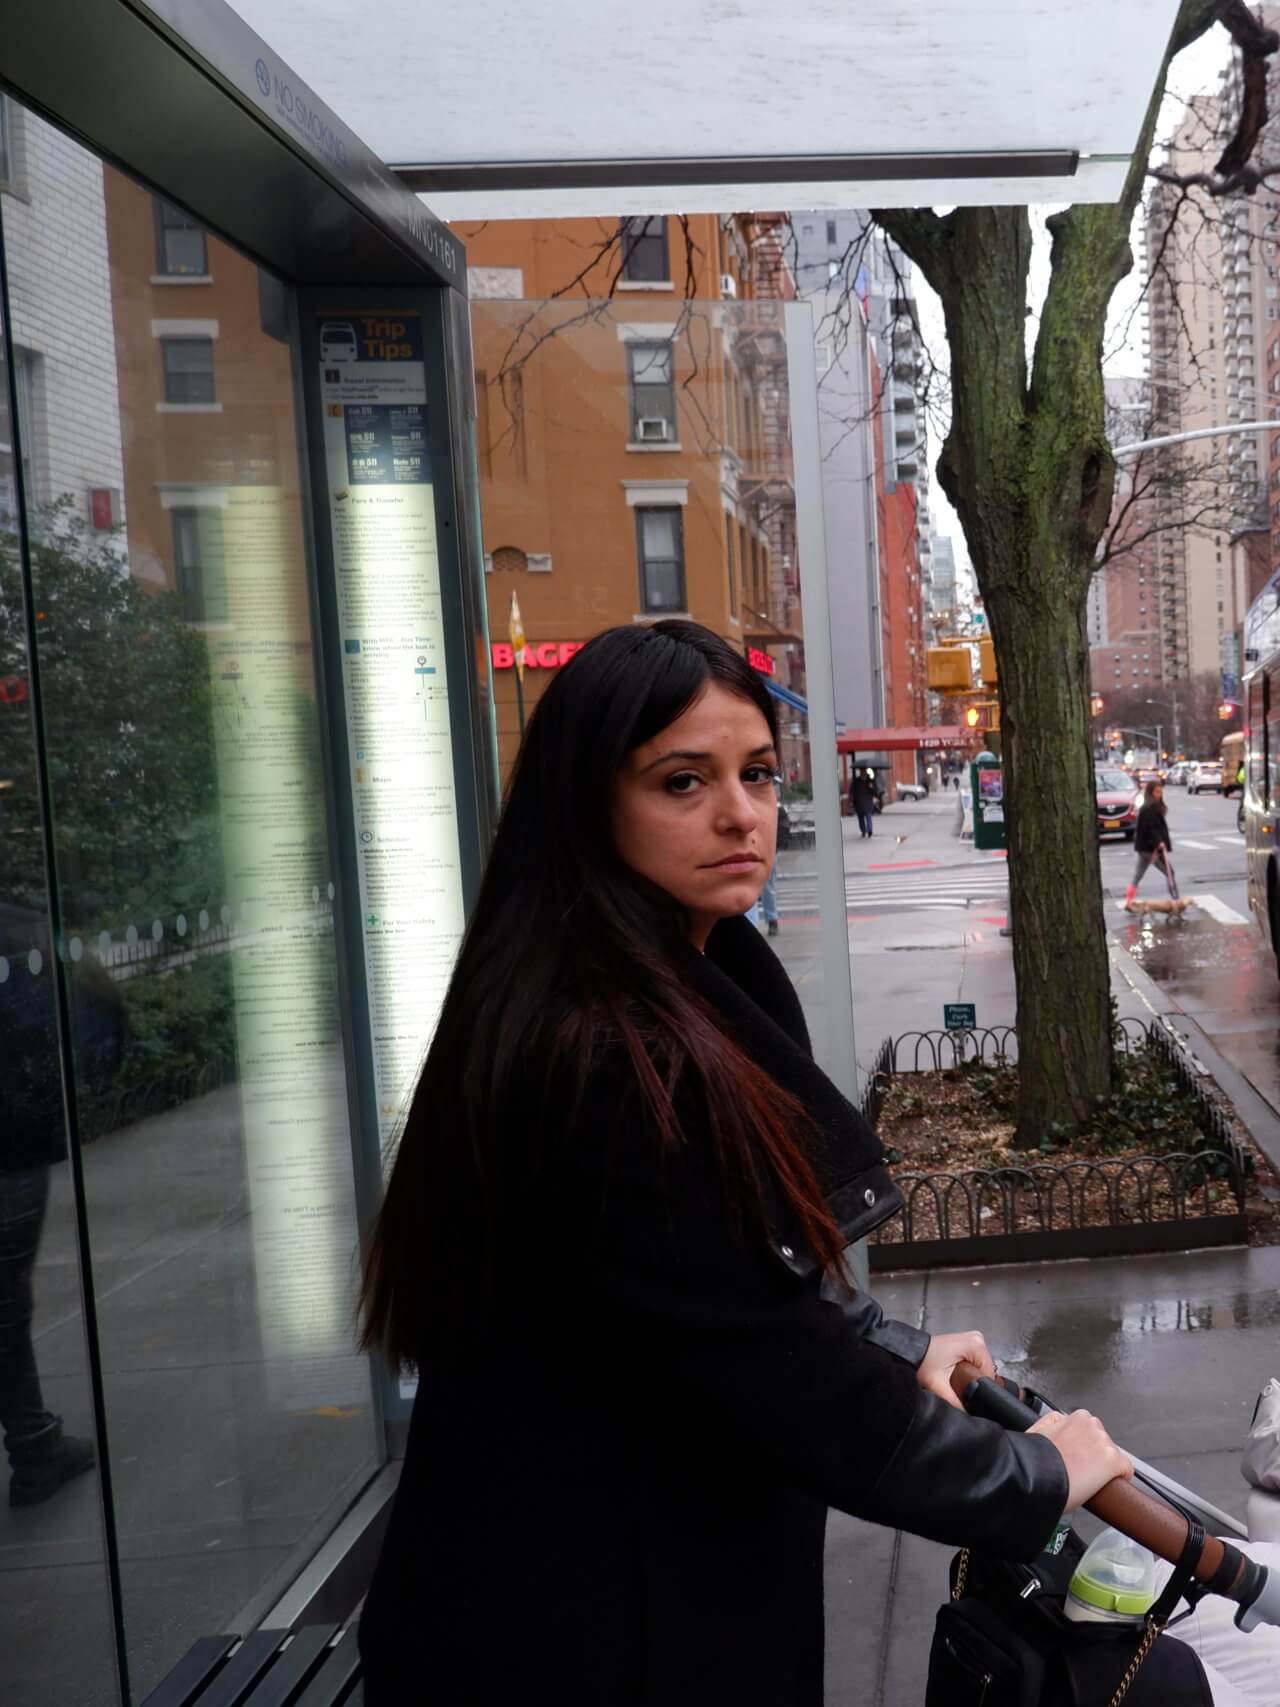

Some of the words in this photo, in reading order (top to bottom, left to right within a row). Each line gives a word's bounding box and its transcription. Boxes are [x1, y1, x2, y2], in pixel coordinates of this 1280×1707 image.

[361, 318, 407, 341] Trip
[362, 340, 413, 362] Tips
[492, 641, 586, 669] BAGE
